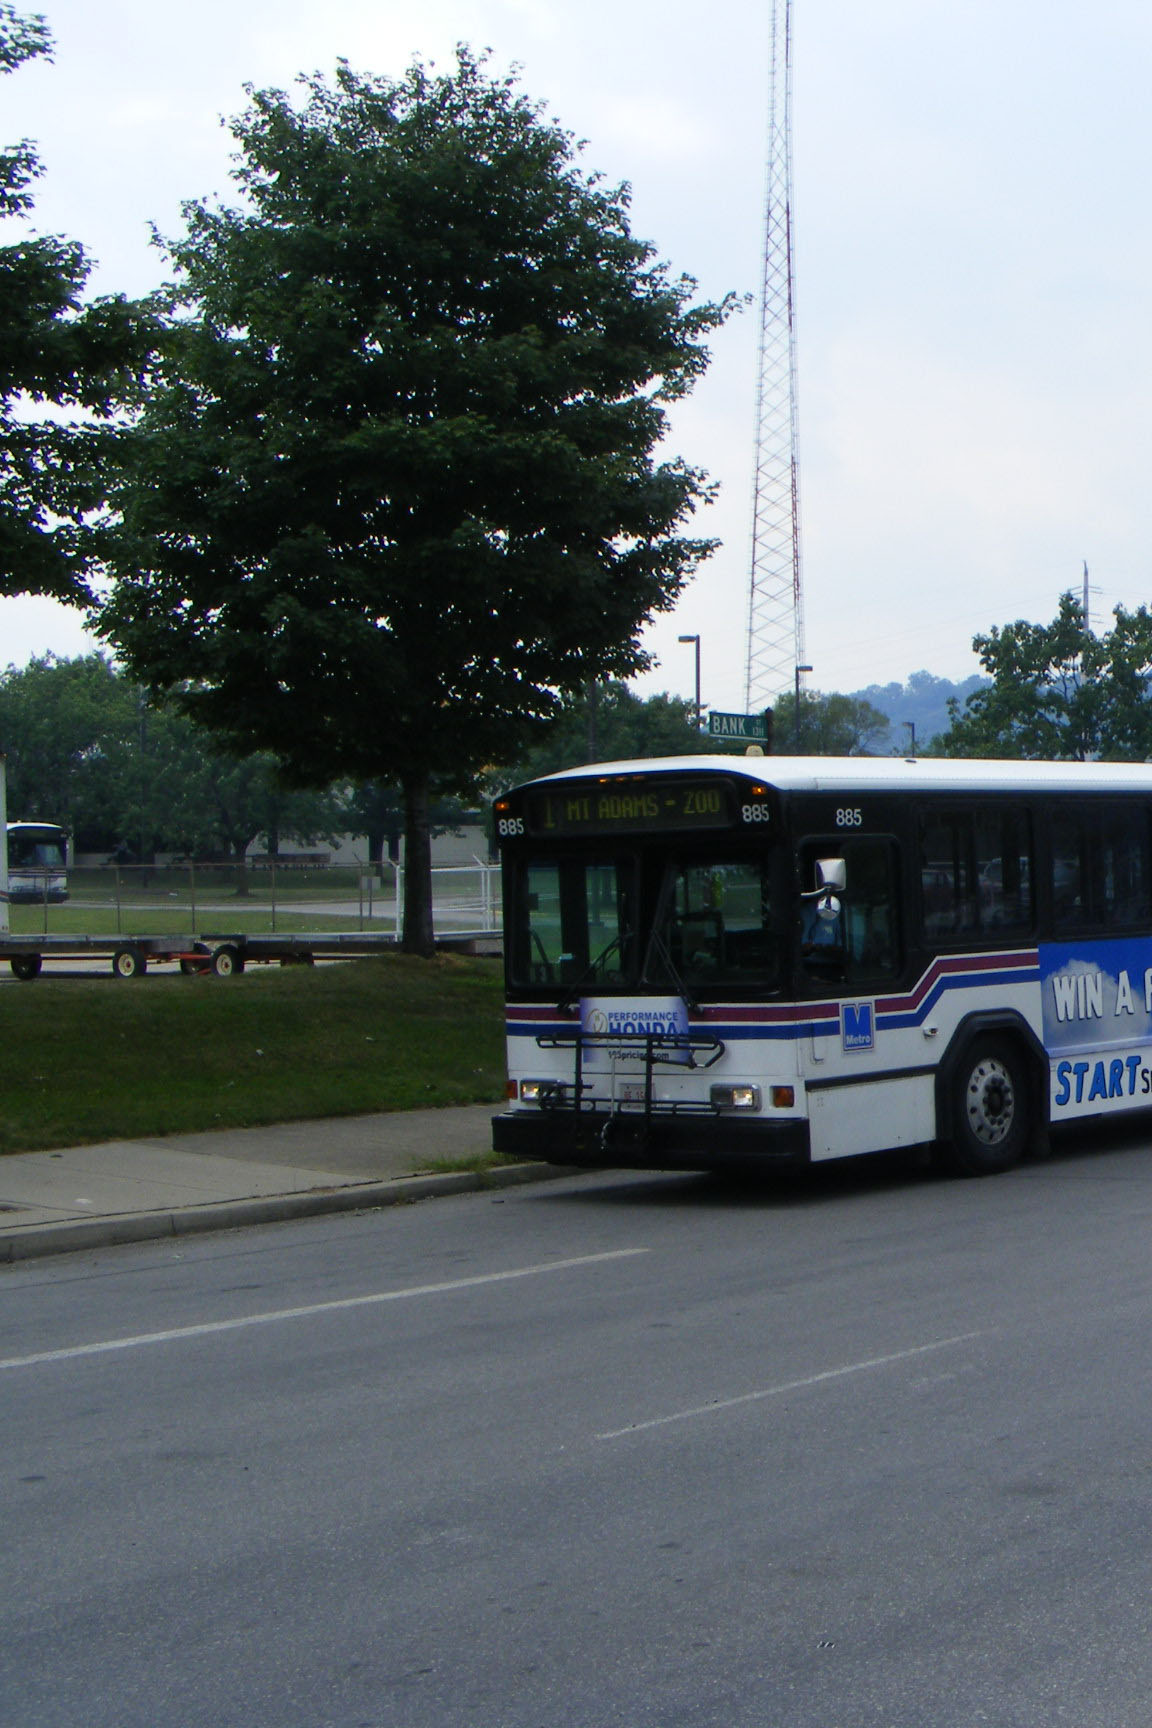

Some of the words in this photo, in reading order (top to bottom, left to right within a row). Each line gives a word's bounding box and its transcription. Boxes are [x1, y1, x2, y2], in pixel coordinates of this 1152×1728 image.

[712, 715, 746, 736] BANK
[567, 798, 591, 821] MT
[599, 793, 659, 819] ADAMS
[683, 790, 721, 815] ZOO
[741, 804, 770, 823] 885
[499, 818, 525, 836] 885
[835, 808, 863, 827] 885
[1053, 972, 1103, 1022] WIN
[1114, 969, 1135, 1017] A
[608, 1011, 679, 1021] PERFORMANCE
[609, 1021, 678, 1035] HONDA
[846, 1034, 871, 1045] Metro
